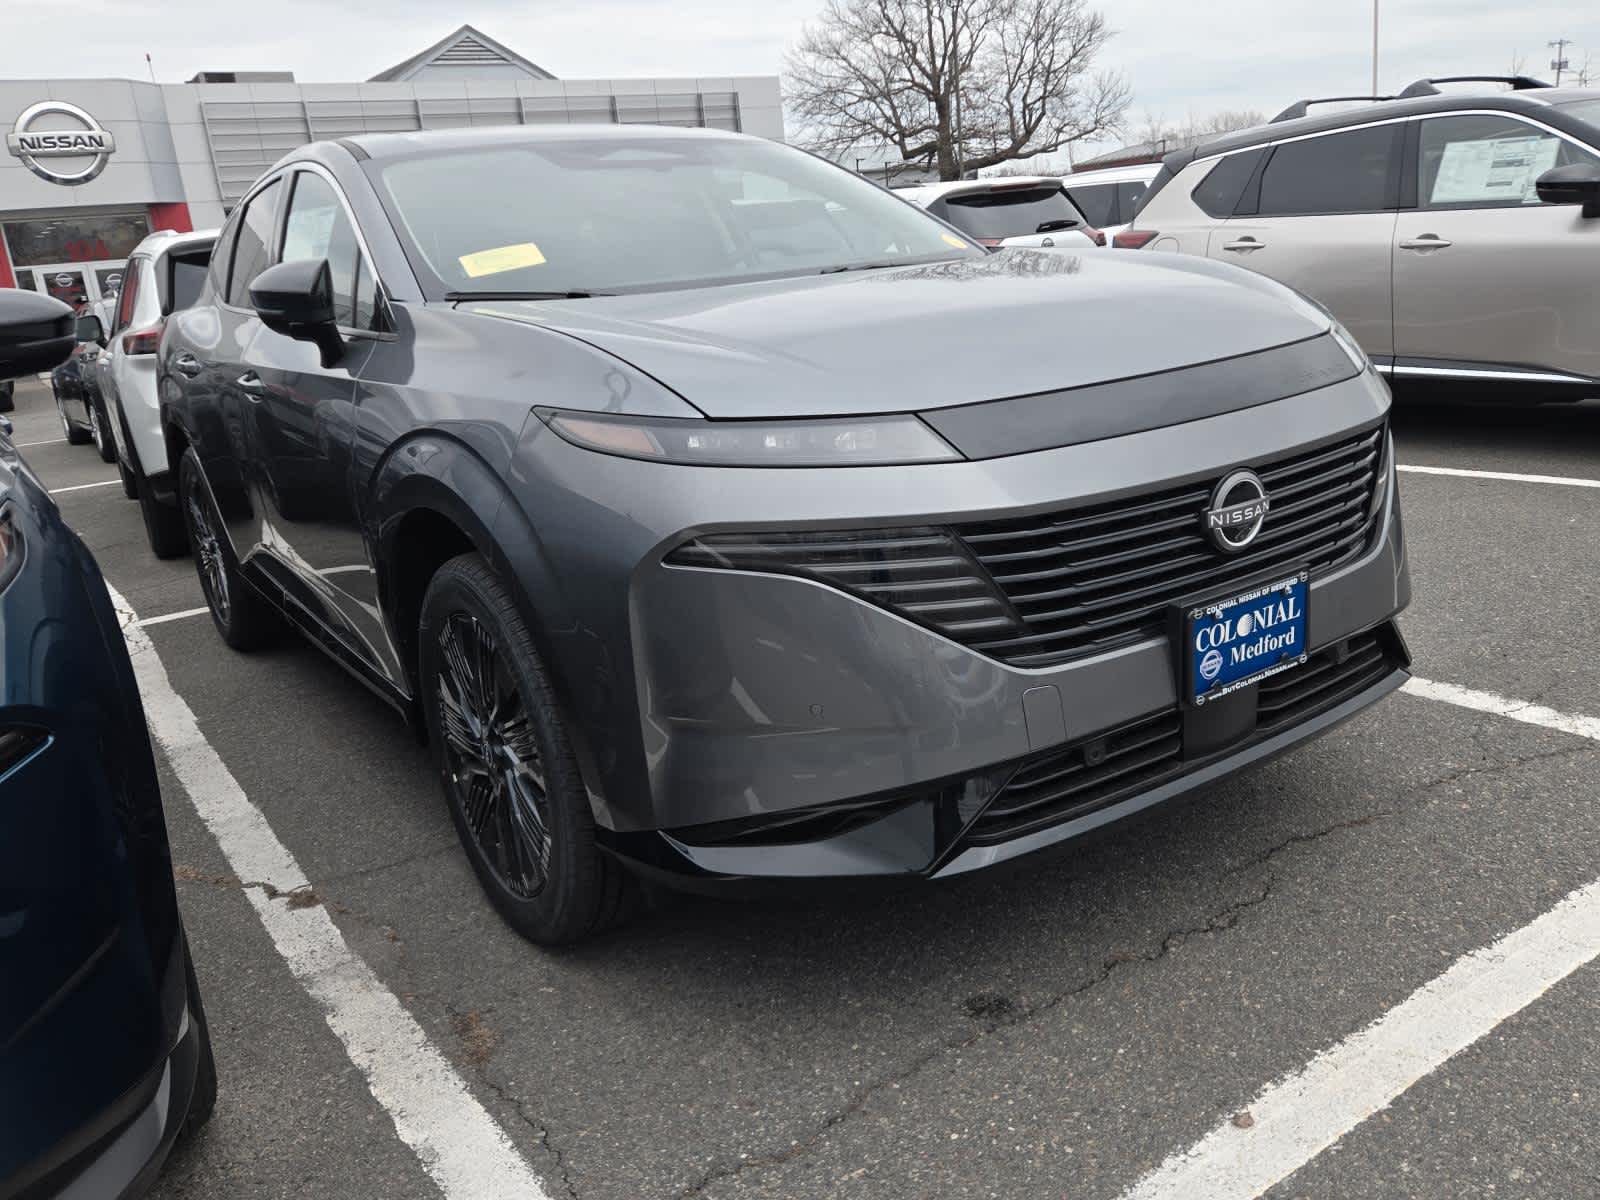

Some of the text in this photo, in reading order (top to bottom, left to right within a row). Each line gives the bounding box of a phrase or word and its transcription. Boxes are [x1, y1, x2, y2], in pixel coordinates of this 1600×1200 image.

[19, 134, 105, 150] NISSAN
[1210, 500, 1270, 527] NISSAN
[1206, 577, 1298, 615] COLONIAL NISSAN OF MEDFORD
[1230, 626, 1296, 666] Medford
